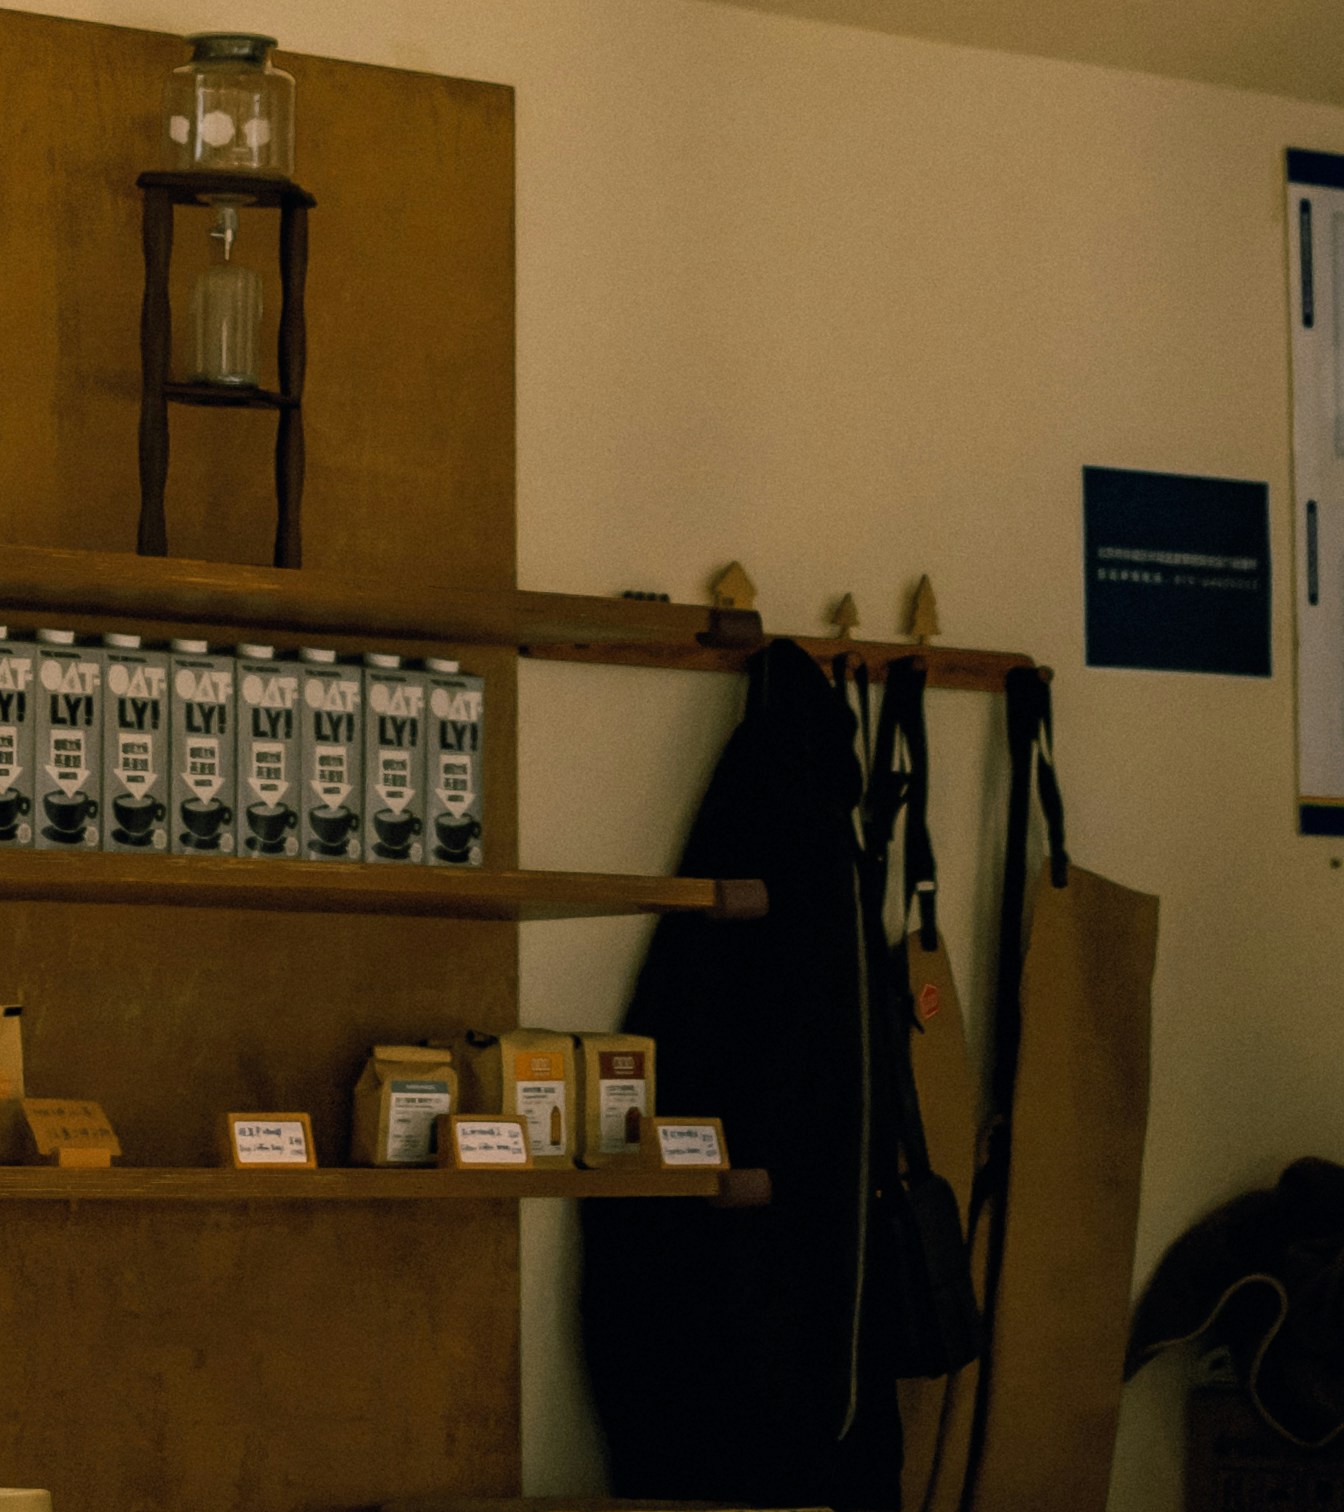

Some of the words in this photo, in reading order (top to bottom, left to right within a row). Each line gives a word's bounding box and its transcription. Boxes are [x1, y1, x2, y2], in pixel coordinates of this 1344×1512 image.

[51, 695, 93, 726] LY!
[118, 698, 160, 730] LY!
[185, 703, 226, 734] LY!
[252, 708, 293, 739] LY!
[314, 712, 355, 742] LY!
[379, 716, 418, 747] LY!
[439, 721, 478, 751] LY!
